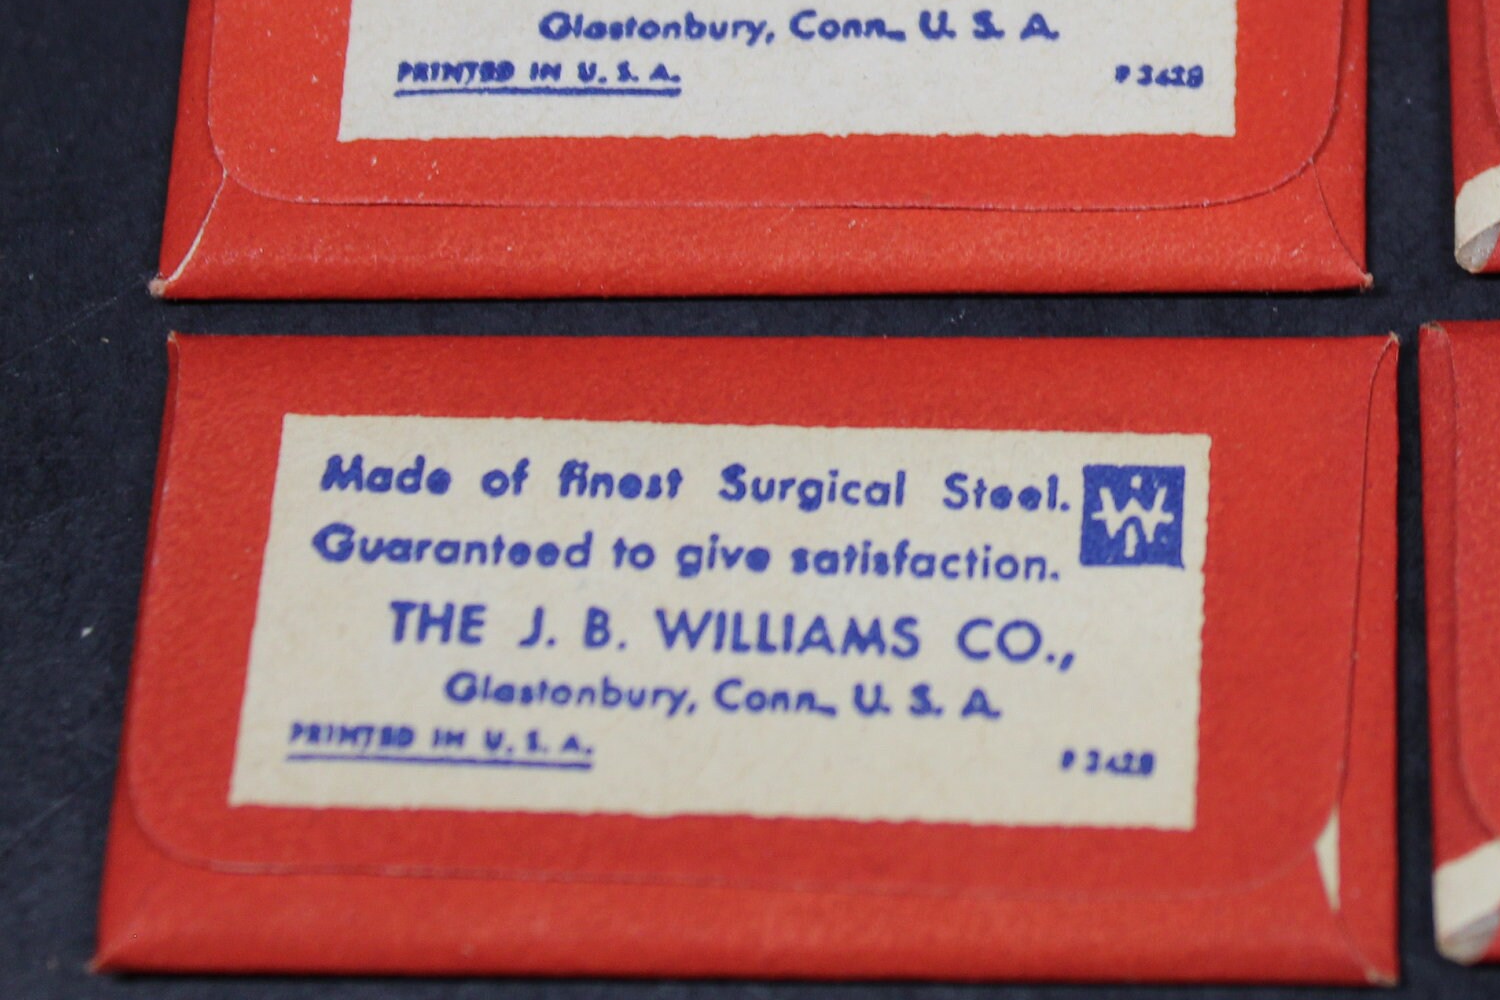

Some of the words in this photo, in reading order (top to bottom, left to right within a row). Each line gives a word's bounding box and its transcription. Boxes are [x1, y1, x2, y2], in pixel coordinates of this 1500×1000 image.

[538, 10, 776, 47] Glastonbury,
[918, 9, 957, 41] U.
[972, 9, 1006, 41] S.
[1019, 12, 1060, 42] A.
[319, 453, 452, 496] Made
[480, 457, 530, 499] of
[558, 458, 684, 500] finest
[718, 462, 907, 513] Surgical
[942, 471, 1071, 513] Steel.
[311, 521, 594, 569] Guaranteed
[612, 537, 656, 571] to
[675, 533, 771, 579] give
[790, 538, 1060, 582] satisfaction.
[389, 600, 487, 646] THE
[518, 606, 556, 649] J.
[583, 606, 626, 650] B.
[654, 608, 921, 660] WILLIAMS
[956, 617, 1075, 672] CO.,
[443, 670, 696, 718] Glastonbury,
[852, 683, 891, 717] U.
[908, 683, 944, 718] S.
[960, 688, 1001, 720] A.
